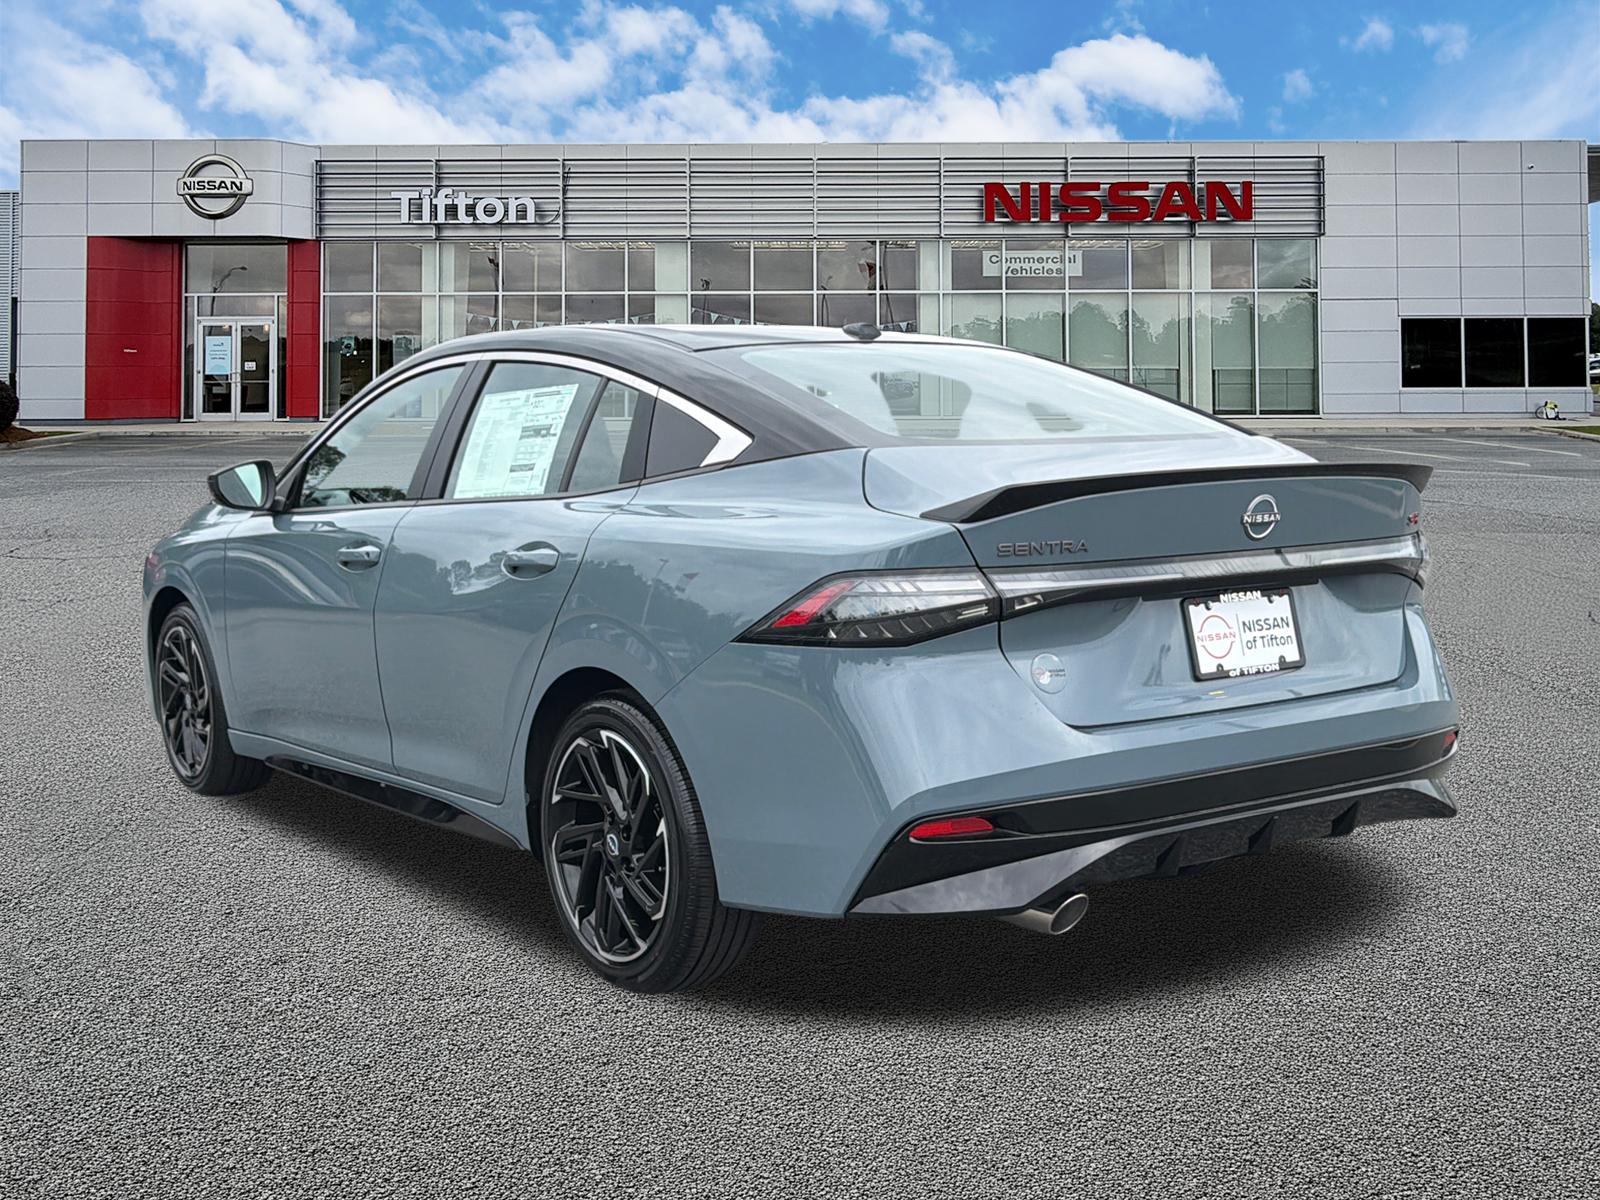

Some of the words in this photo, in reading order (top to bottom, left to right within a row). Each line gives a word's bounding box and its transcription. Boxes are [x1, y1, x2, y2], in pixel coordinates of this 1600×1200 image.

[183, 180, 243, 191] NISSAN
[391, 187, 536, 224] Tifton
[983, 181, 1254, 222] NISSAN
[1243, 513, 1280, 523] NISSAN
[997, 540, 1088, 557] SENTRA
[1219, 590, 1262, 604] NISSAN
[1242, 616, 1290, 634] NISSAN
[1197, 631, 1236, 643] NISSAN
[1246, 637, 1258, 650] of
[1260, 634, 1293, 649] Tifton
[1229, 667, 1241, 677] of
[1241, 663, 1280, 675] TIFTON
